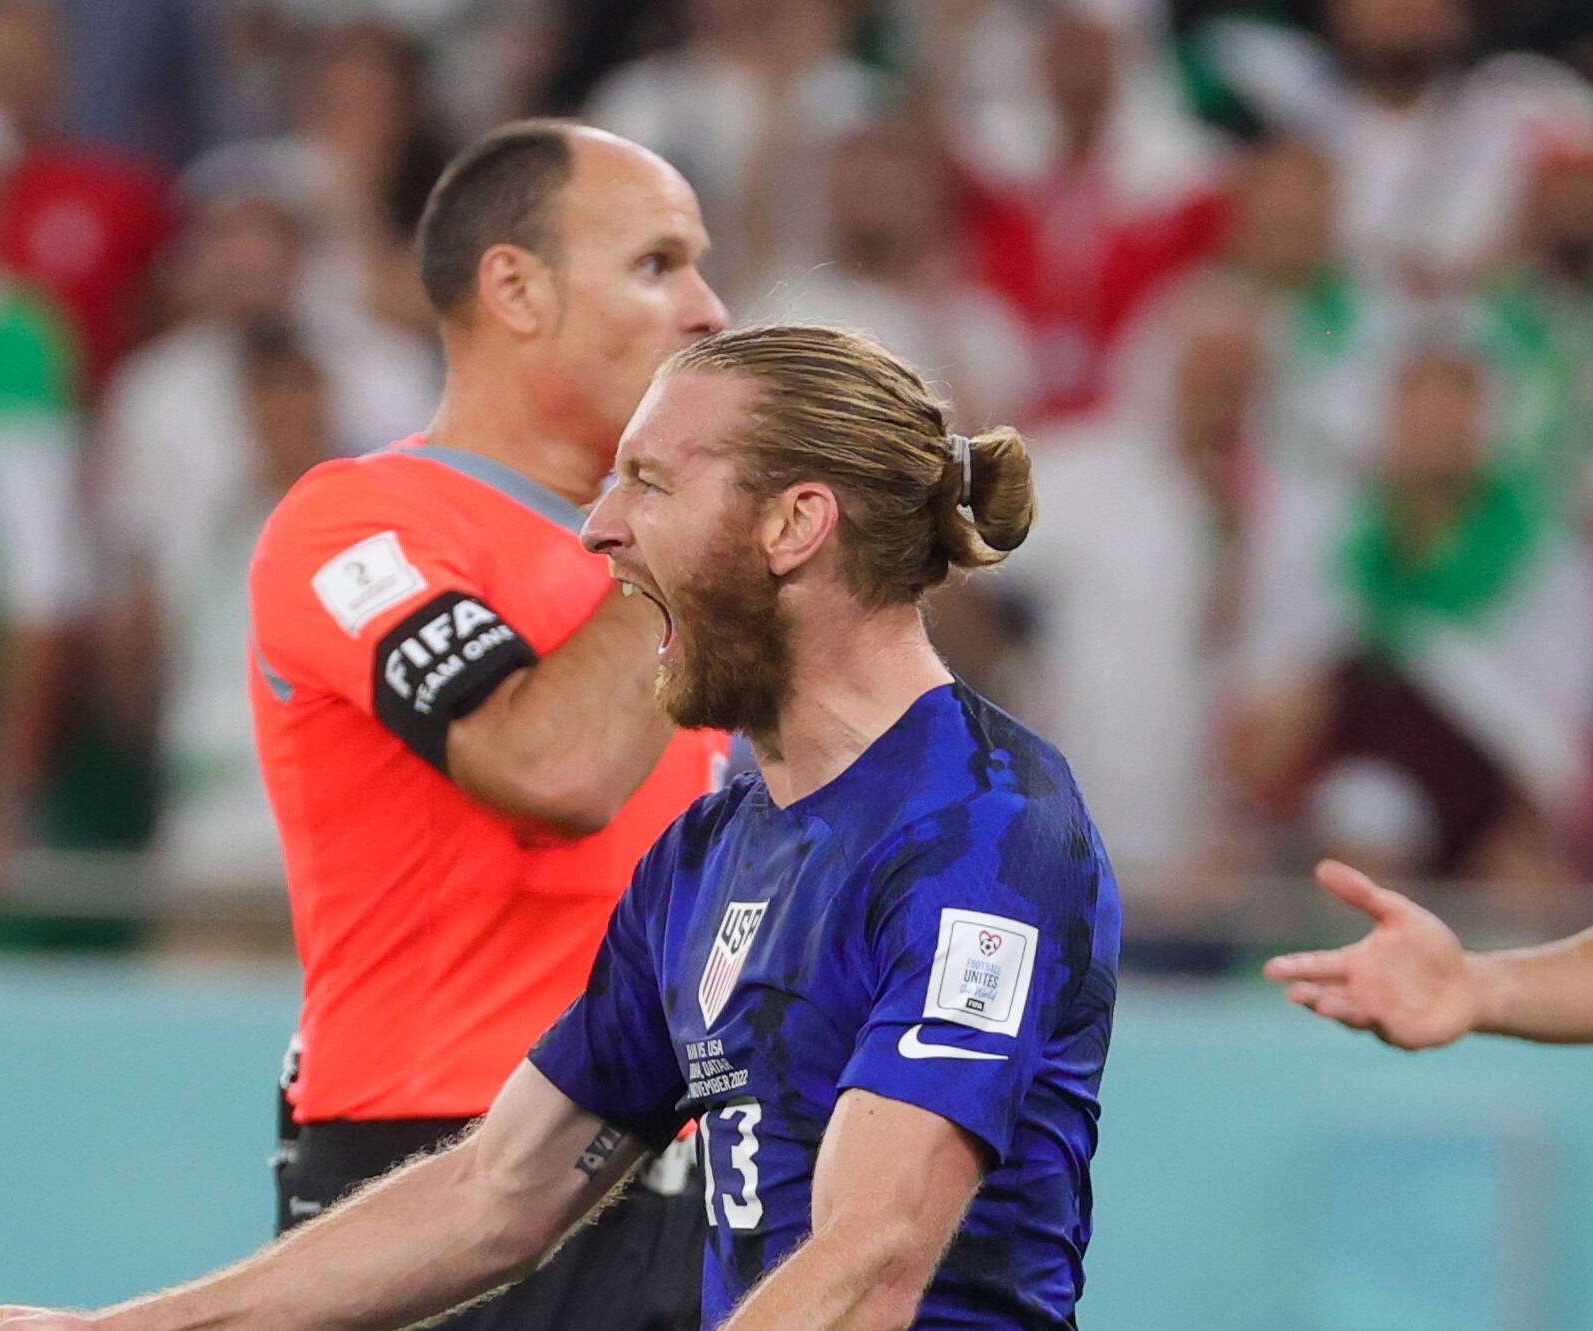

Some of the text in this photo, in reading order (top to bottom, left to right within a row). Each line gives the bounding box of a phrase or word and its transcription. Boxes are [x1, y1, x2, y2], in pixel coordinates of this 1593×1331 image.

[385, 599, 498, 700] FIFA
[413, 654, 466, 714] TEAM
[721, 908, 764, 955] USA
[963, 968, 1000, 989] UNITES
[707, 1039, 724, 1057] USA
[702, 1058, 735, 1077] QATAR
[728, 1068, 748, 1089] 2022
[699, 1098, 764, 1229] 13
